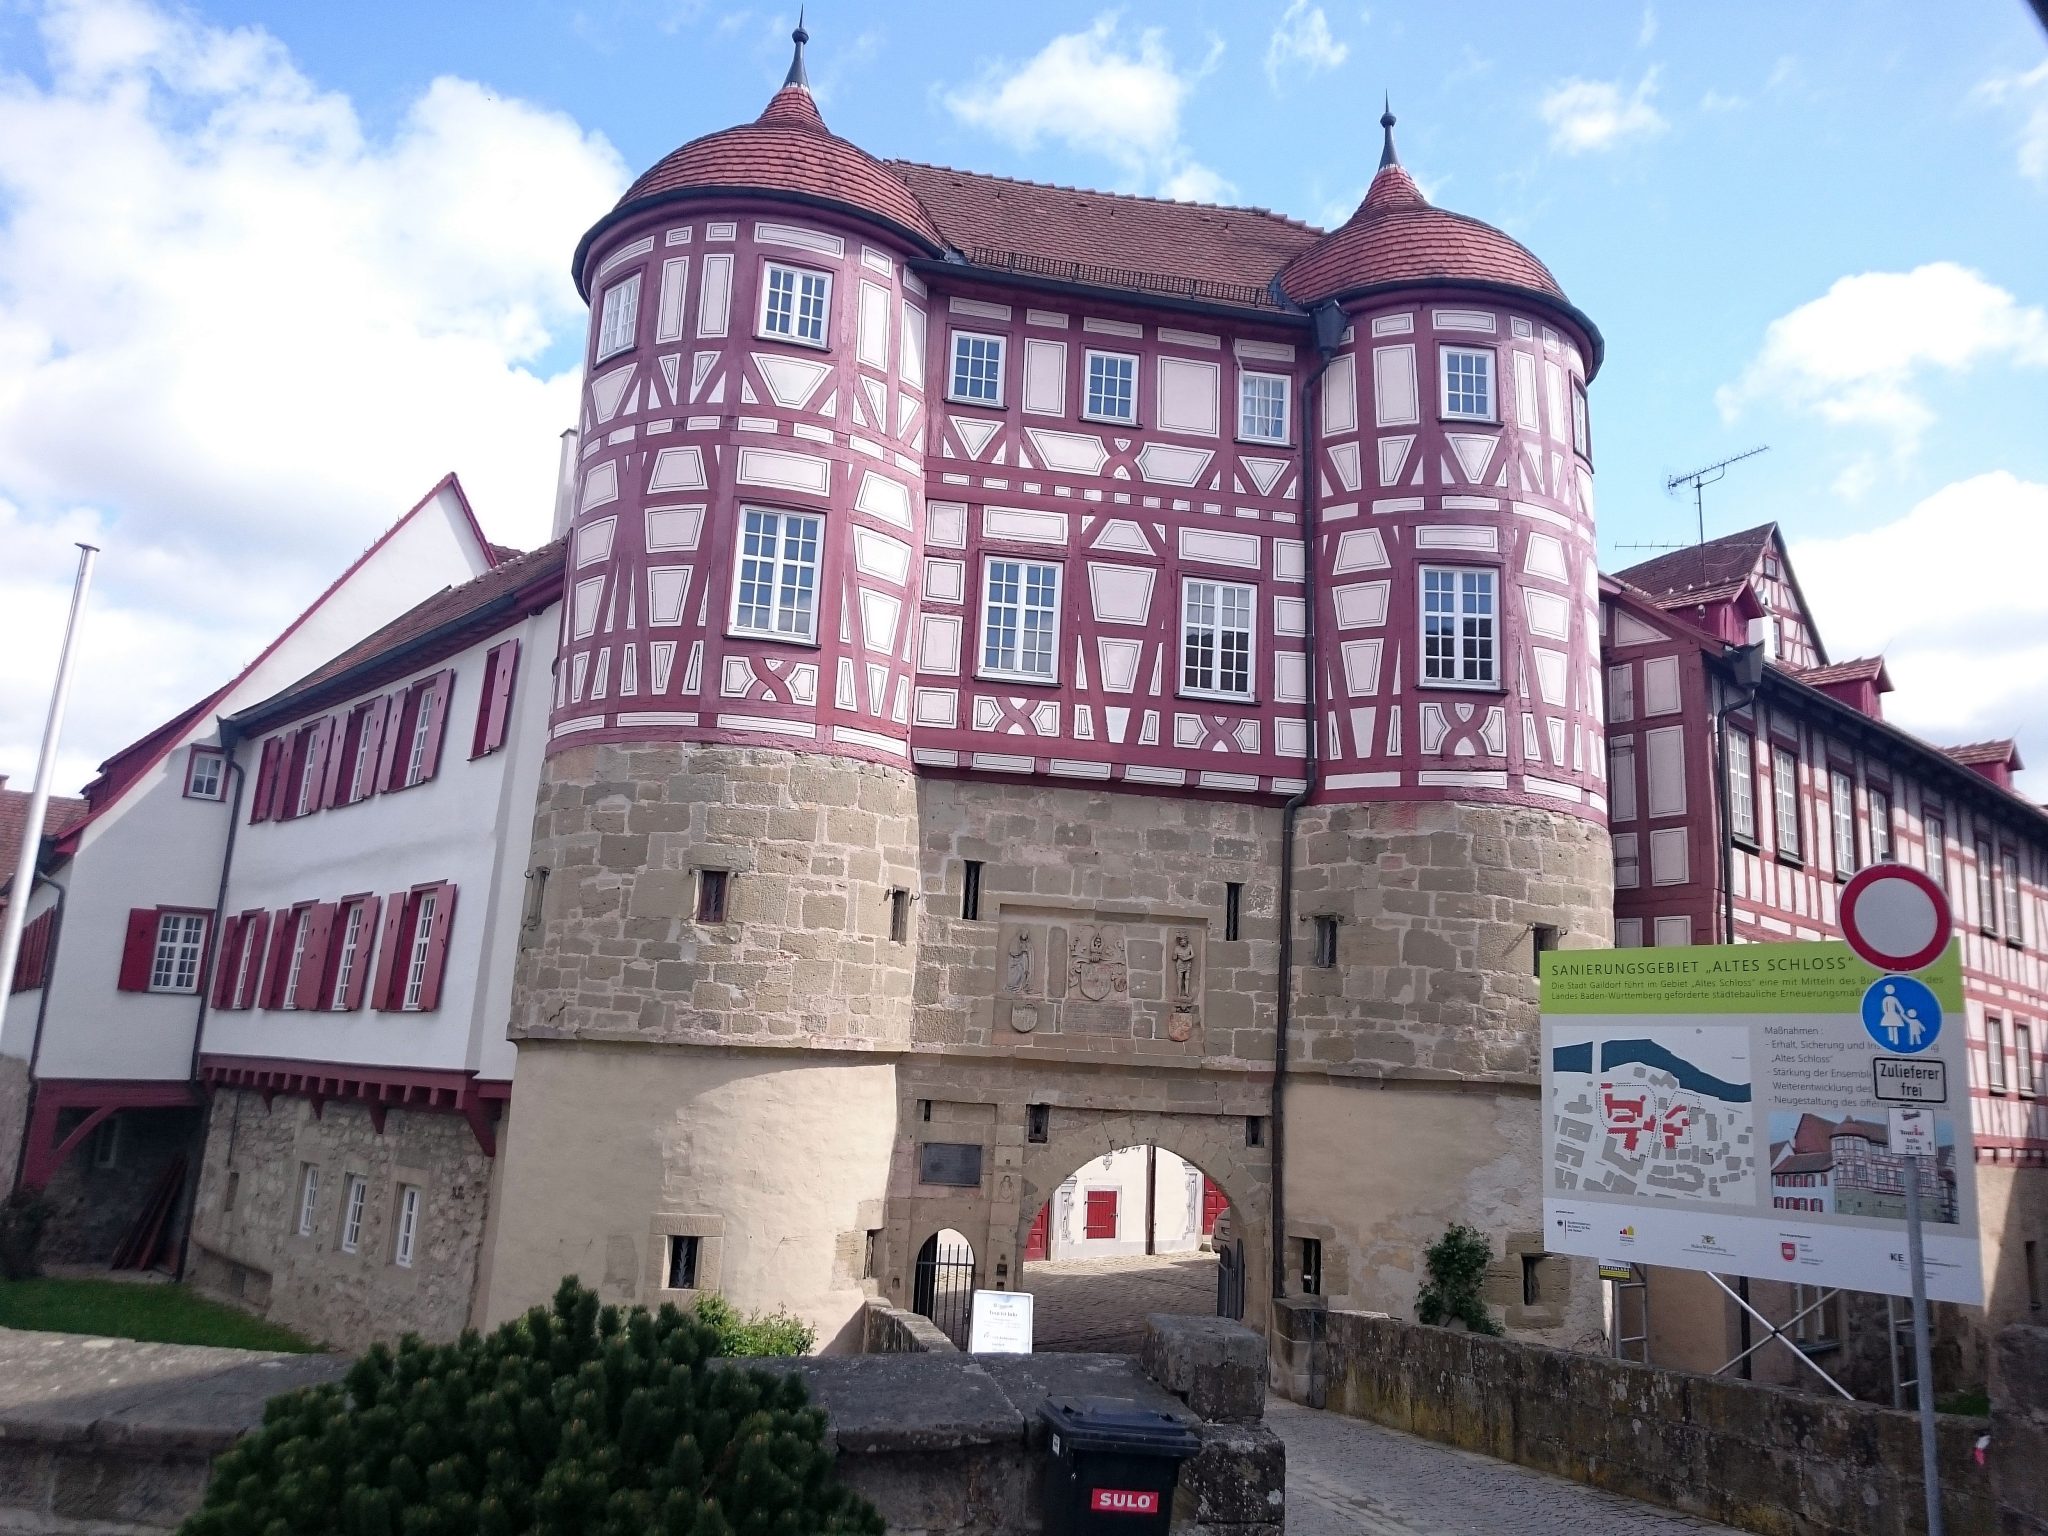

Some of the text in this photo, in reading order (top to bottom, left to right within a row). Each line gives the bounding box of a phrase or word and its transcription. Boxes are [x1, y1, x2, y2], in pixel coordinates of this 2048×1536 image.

[1551, 960, 1699, 976] SANIERUNGSGEBIET
[1551, 981, 1565, 990] Die
[1567, 981, 1587, 990] Stadt
[1589, 980, 1621, 990] Gaildorf
[1647, 980, 1657, 988] im
[1660, 979, 1688, 988] Gebiet
[1759, 979, 1779, 987] eine
[1782, 977, 1798, 986] mit
[1801, 976, 1835, 986] Mitteln
[1839, 976, 1856, 985] des
[1551, 991, 1578, 1000] Landes
[1764, 1026, 1819, 1035] Maßnahmen
[1771, 1040, 1798, 1049] Erhalt,
[1800, 1040, 1845, 1051] Sicherung
[1847, 1041, 1865, 1050] und
[1813, 1068, 1829, 1078] der
[1880, 1063, 1940, 1080] Zulieferer
[1772, 1081, 1873, 1094] Weiterentwicklung des
[1900, 1082, 1923, 1097] frei
[1774, 1095, 1839, 1108] Neugestaltung
[1841, 1098, 1857, 1107] des
[1890, 1253, 1904, 1262] KE
[1099, 1492, 1151, 1508] SULO
